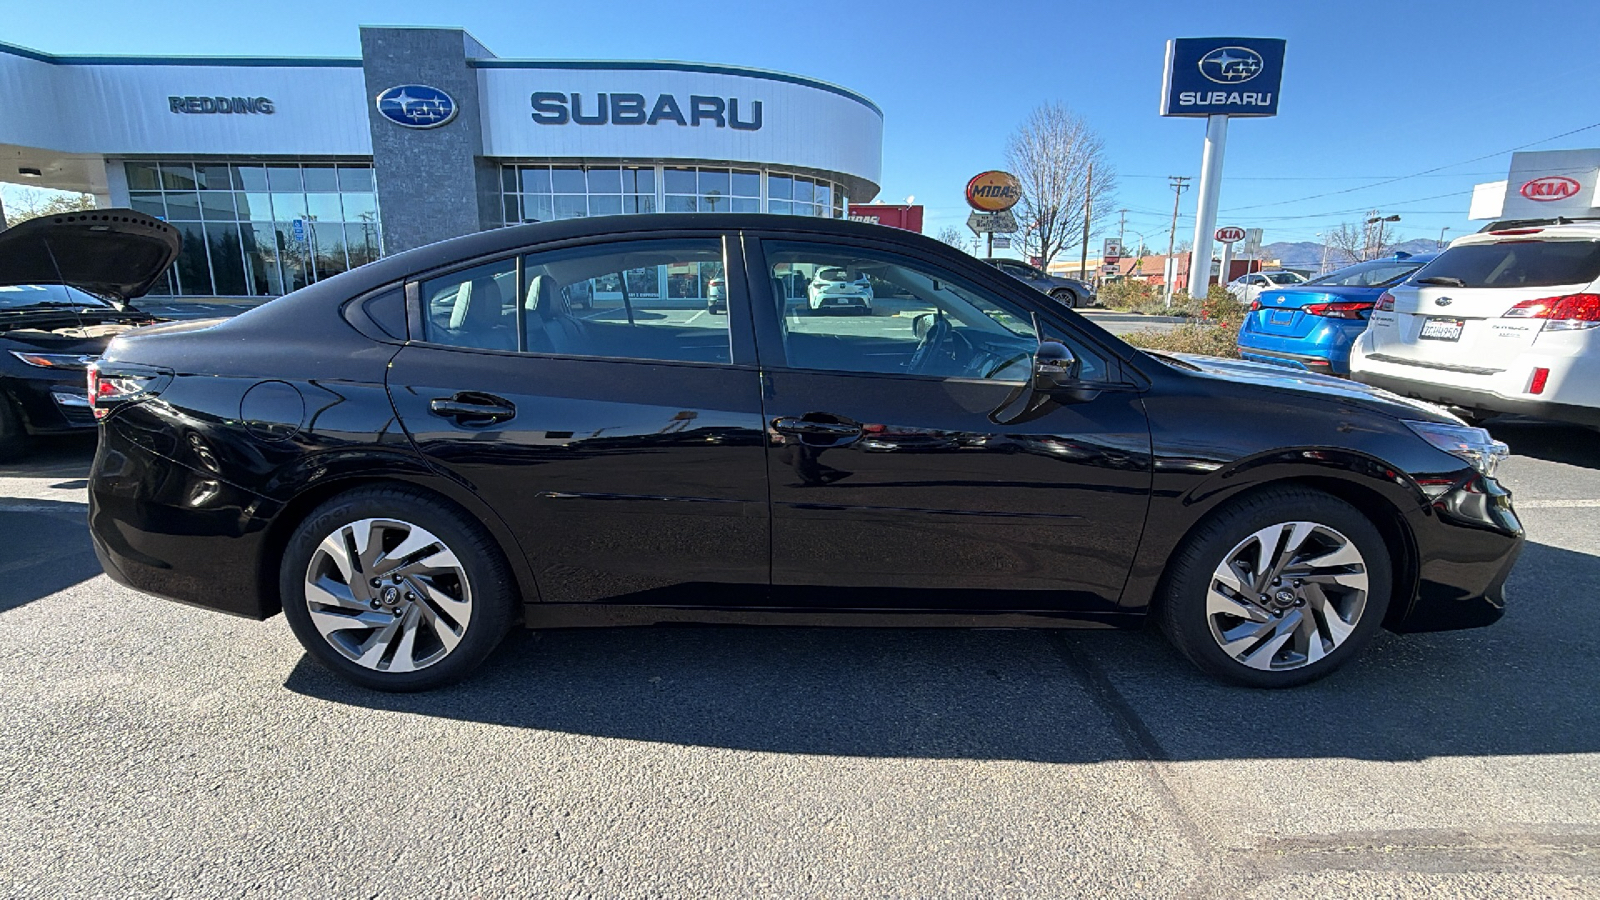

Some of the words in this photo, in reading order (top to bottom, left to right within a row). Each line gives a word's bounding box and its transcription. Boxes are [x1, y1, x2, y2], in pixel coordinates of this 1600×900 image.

[168, 97, 274, 114] REDDING
[1180, 92, 1271, 106] SUBARU
[531, 92, 763, 131] SUBARU
[1531, 183, 1569, 196] KIA
[1221, 230, 1241, 239] KIA
